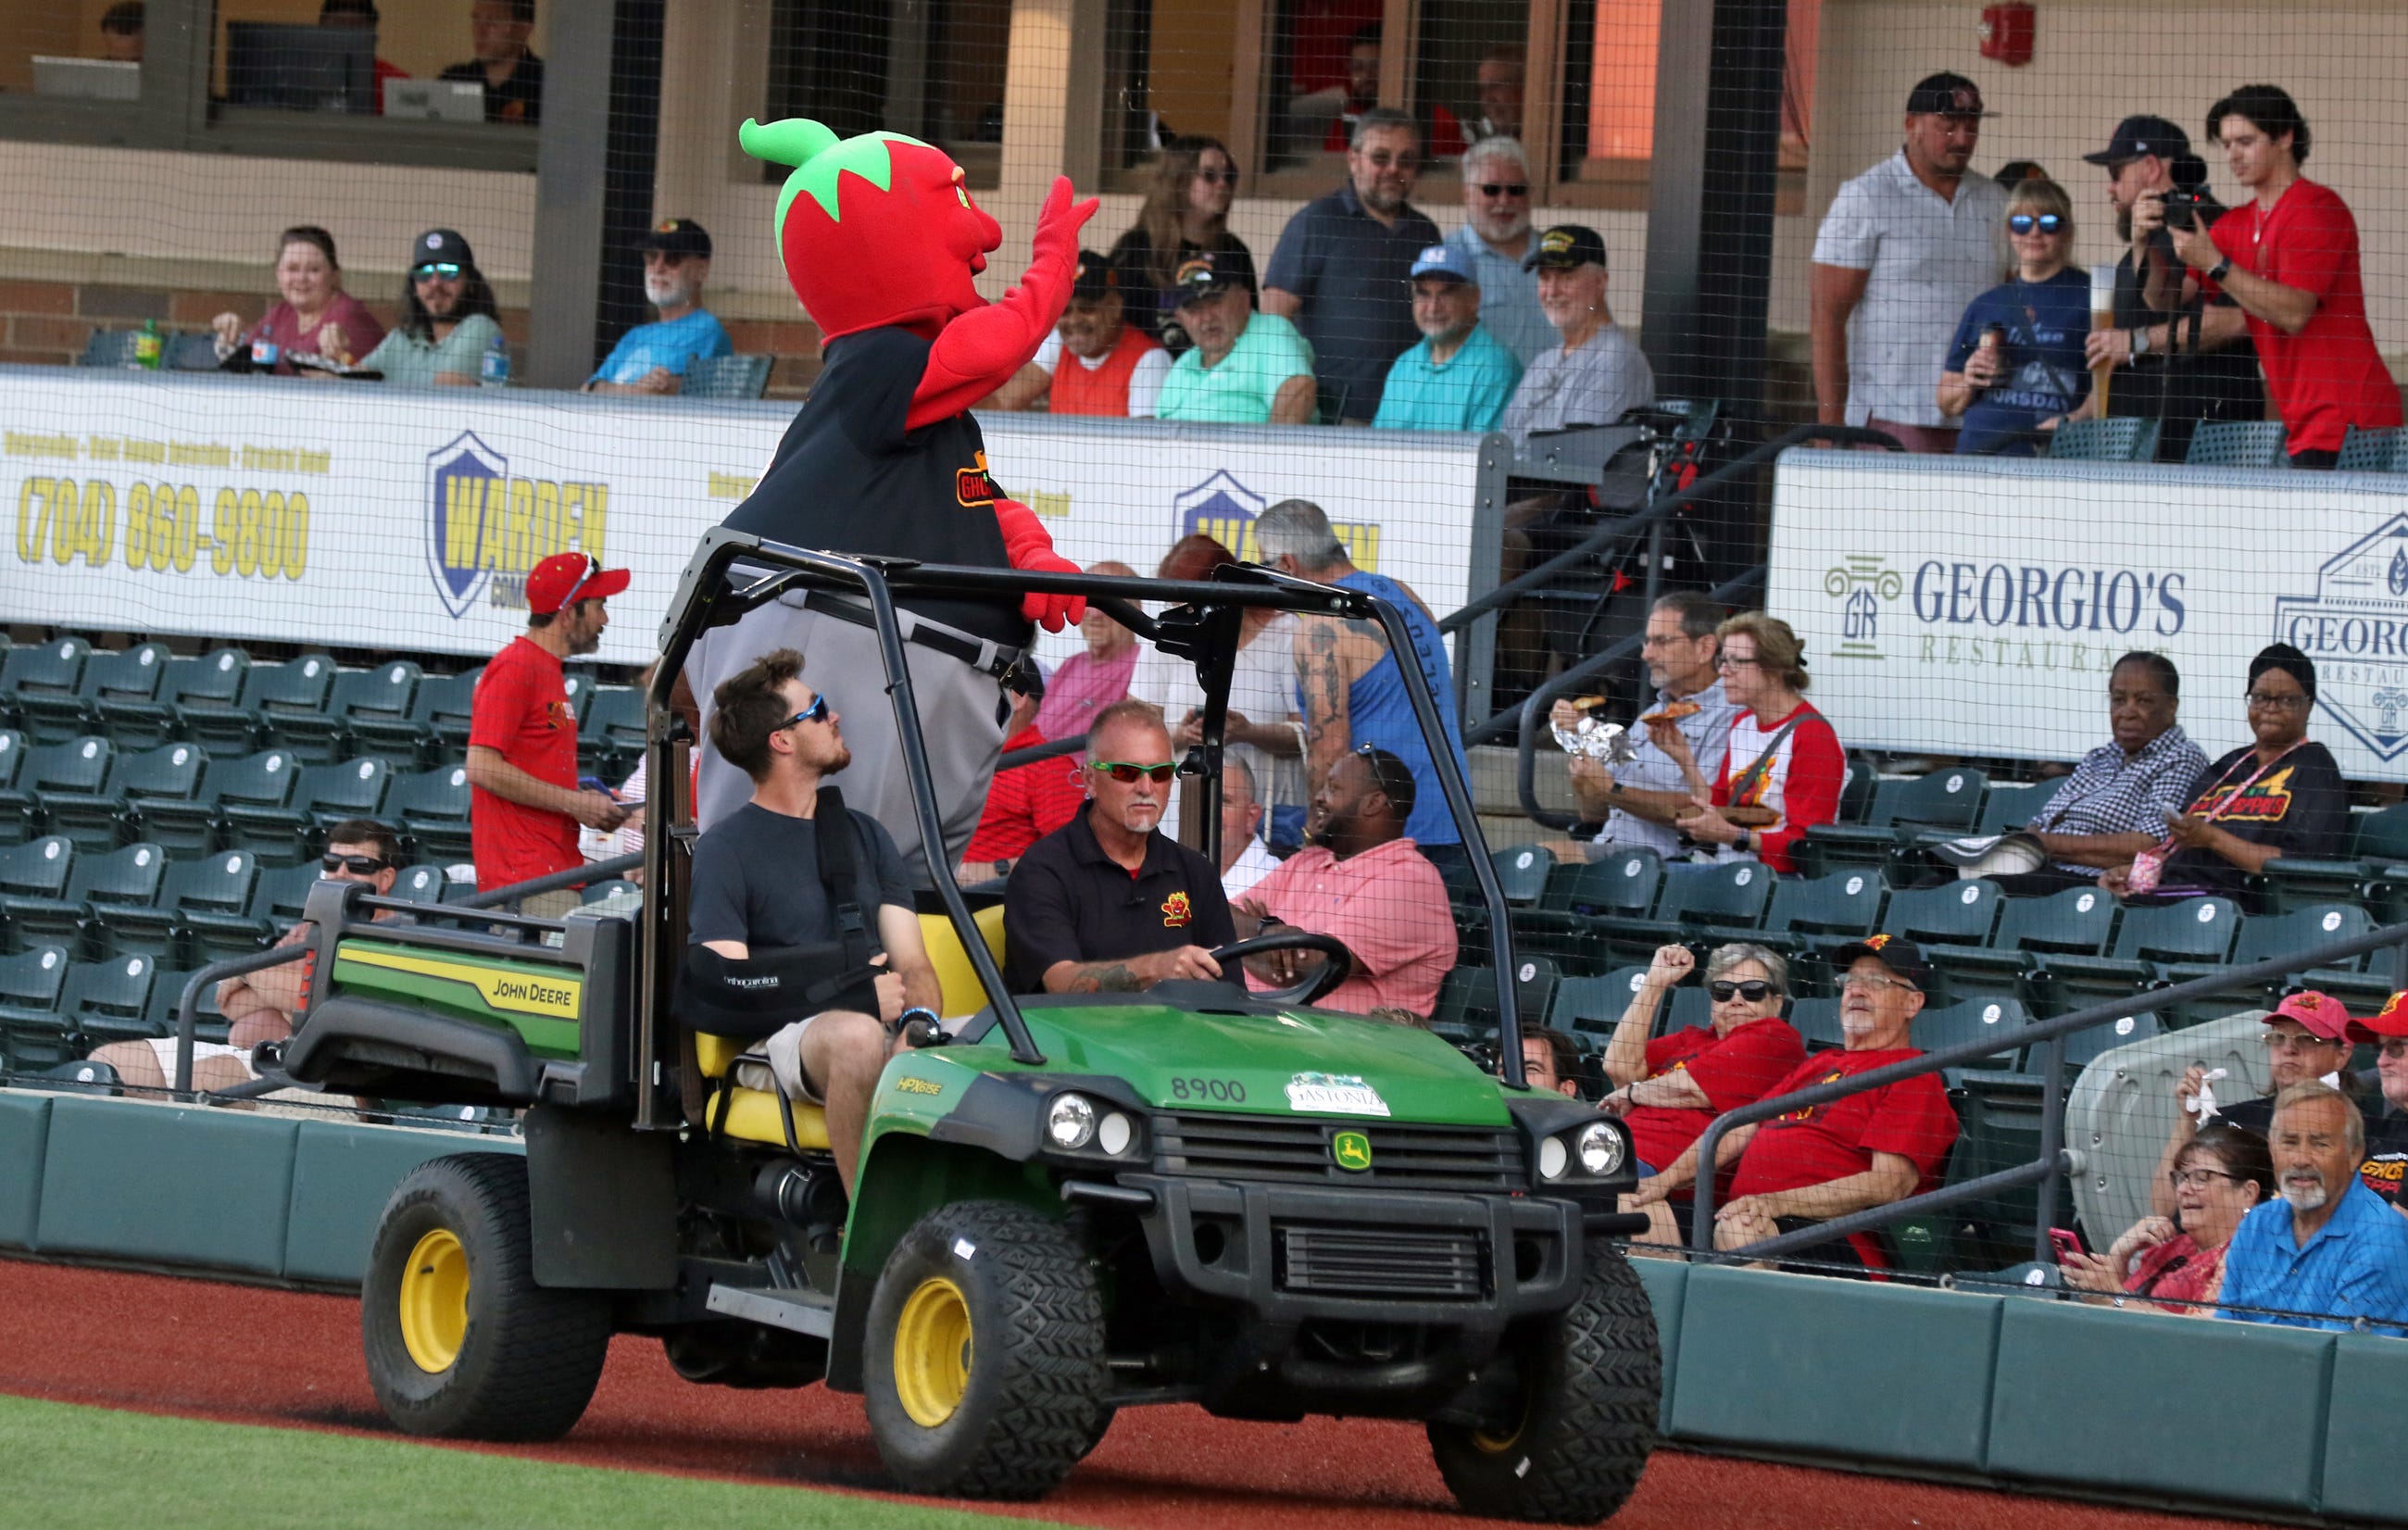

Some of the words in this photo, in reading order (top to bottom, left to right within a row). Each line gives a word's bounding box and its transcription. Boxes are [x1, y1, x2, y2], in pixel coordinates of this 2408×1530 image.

[17, 476, 116, 567] (704)
[125, 481, 309, 581] 860-9800
[445, 475, 608, 571] WARDEN
[1913, 560, 2187, 637] GEORGIO'S
[1919, 633, 2170, 674] RESTAURA
[493, 979, 528, 1000] JOHN
[530, 984, 571, 1007] DEERE
[896, 1076, 943, 1096] HPX615E
[1171, 1077, 1247, 1103] 8900
[1285, 1085, 1386, 1105] GASTONIA
